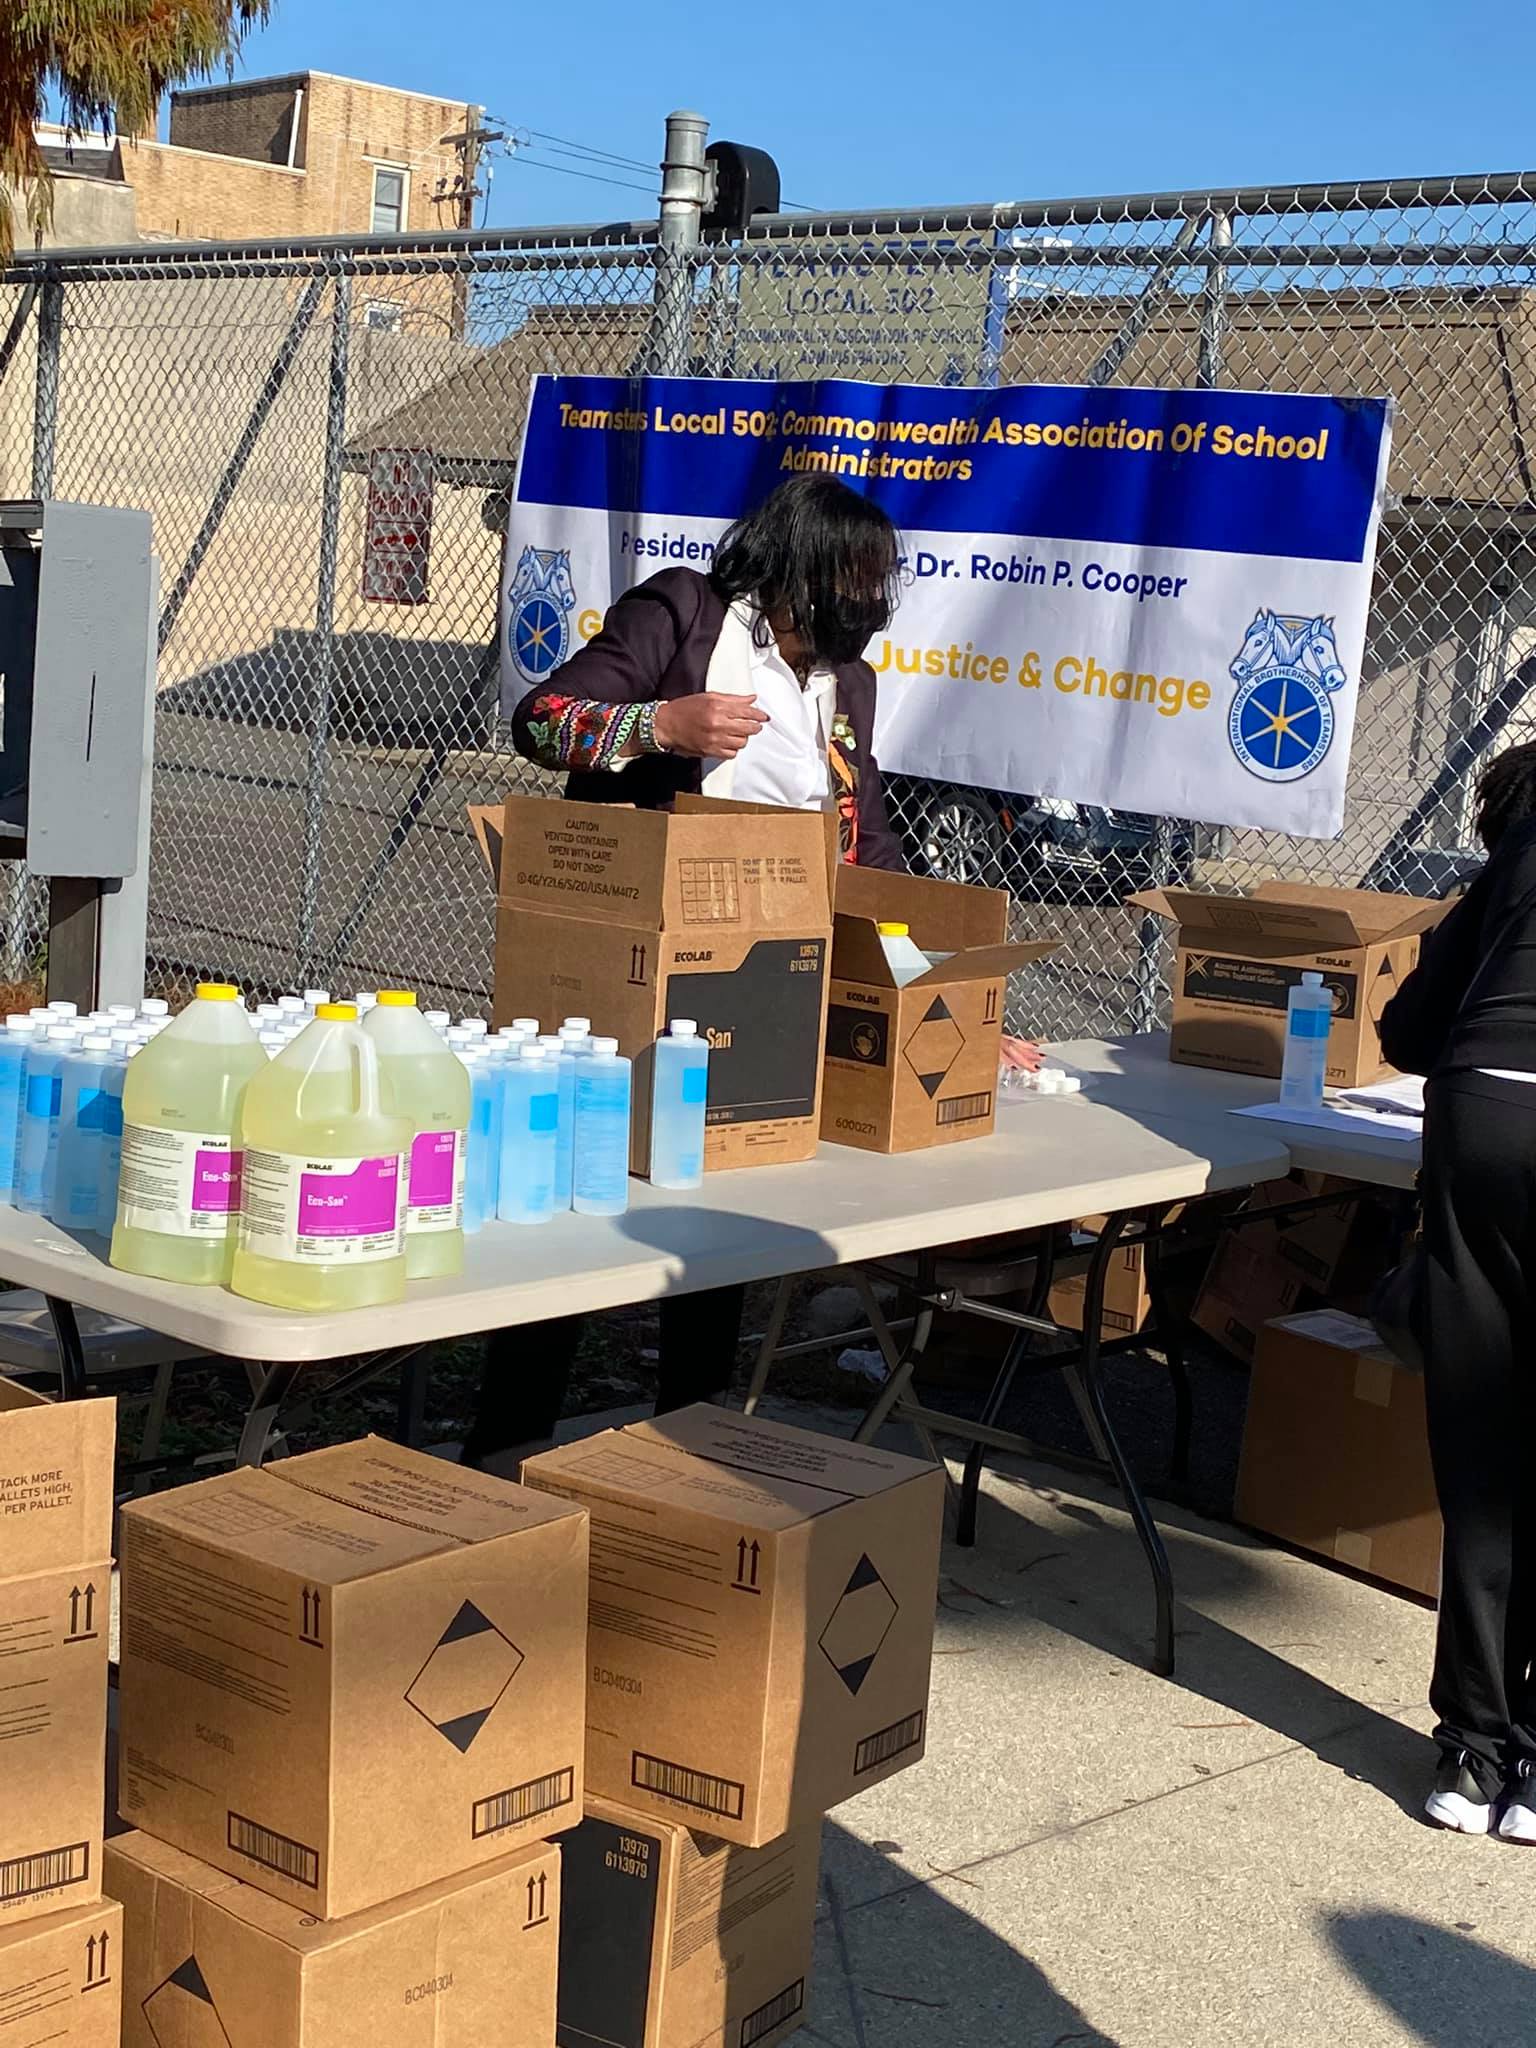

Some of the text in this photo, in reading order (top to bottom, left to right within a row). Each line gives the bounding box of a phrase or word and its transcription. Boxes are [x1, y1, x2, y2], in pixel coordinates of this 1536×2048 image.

[785, 287, 935, 315] LOCAL 502
[559, 403, 1330, 461] Teamsts Local 502 Commonwealth Association Of School
[779, 444, 973, 482] Administrators
[620, 530, 715, 561] Pesiden
[915, 551, 961, 579] Dr.
[970, 554, 1046, 587] Robin
[1051, 560, 1074, 588] P.
[1081, 562, 1188, 603] Cooper
[872, 639, 1212, 717] Justice & Change
[1231, 683, 1255, 763] INTERNATIONAL
[1254, 667, 1320, 696] BROTHERHOOD
[1301, 711, 1332, 772] TEAMSTERS
[565, 818, 599, 832] CAUTION
[575, 834, 618, 848] CONTAINER
[547, 844, 569, 856] OPEN
[591, 850, 612, 862] CARE
[552, 858, 564, 870] DO
[566, 861, 581, 872] NOT
[673, 950, 712, 962] ECOLAB
[1315, 956, 1353, 967] ECOLAB
[846, 991, 880, 1005] ECOLAB
[834, 1116, 878, 1137] 6000271
[306, 1194, 344, 1206] Eco-San
[0, 1470, 63, 1489] TACK MORE
[0, 1486, 41, 1502] ALLETS
[4, 1494, 72, 1515] PER PALLET.
[592, 1666, 643, 1697] BC040304
[617, 1836, 650, 1857] 13979
[604, 1851, 649, 1880] 6113979
[404, 1972, 454, 2006] BC040304
